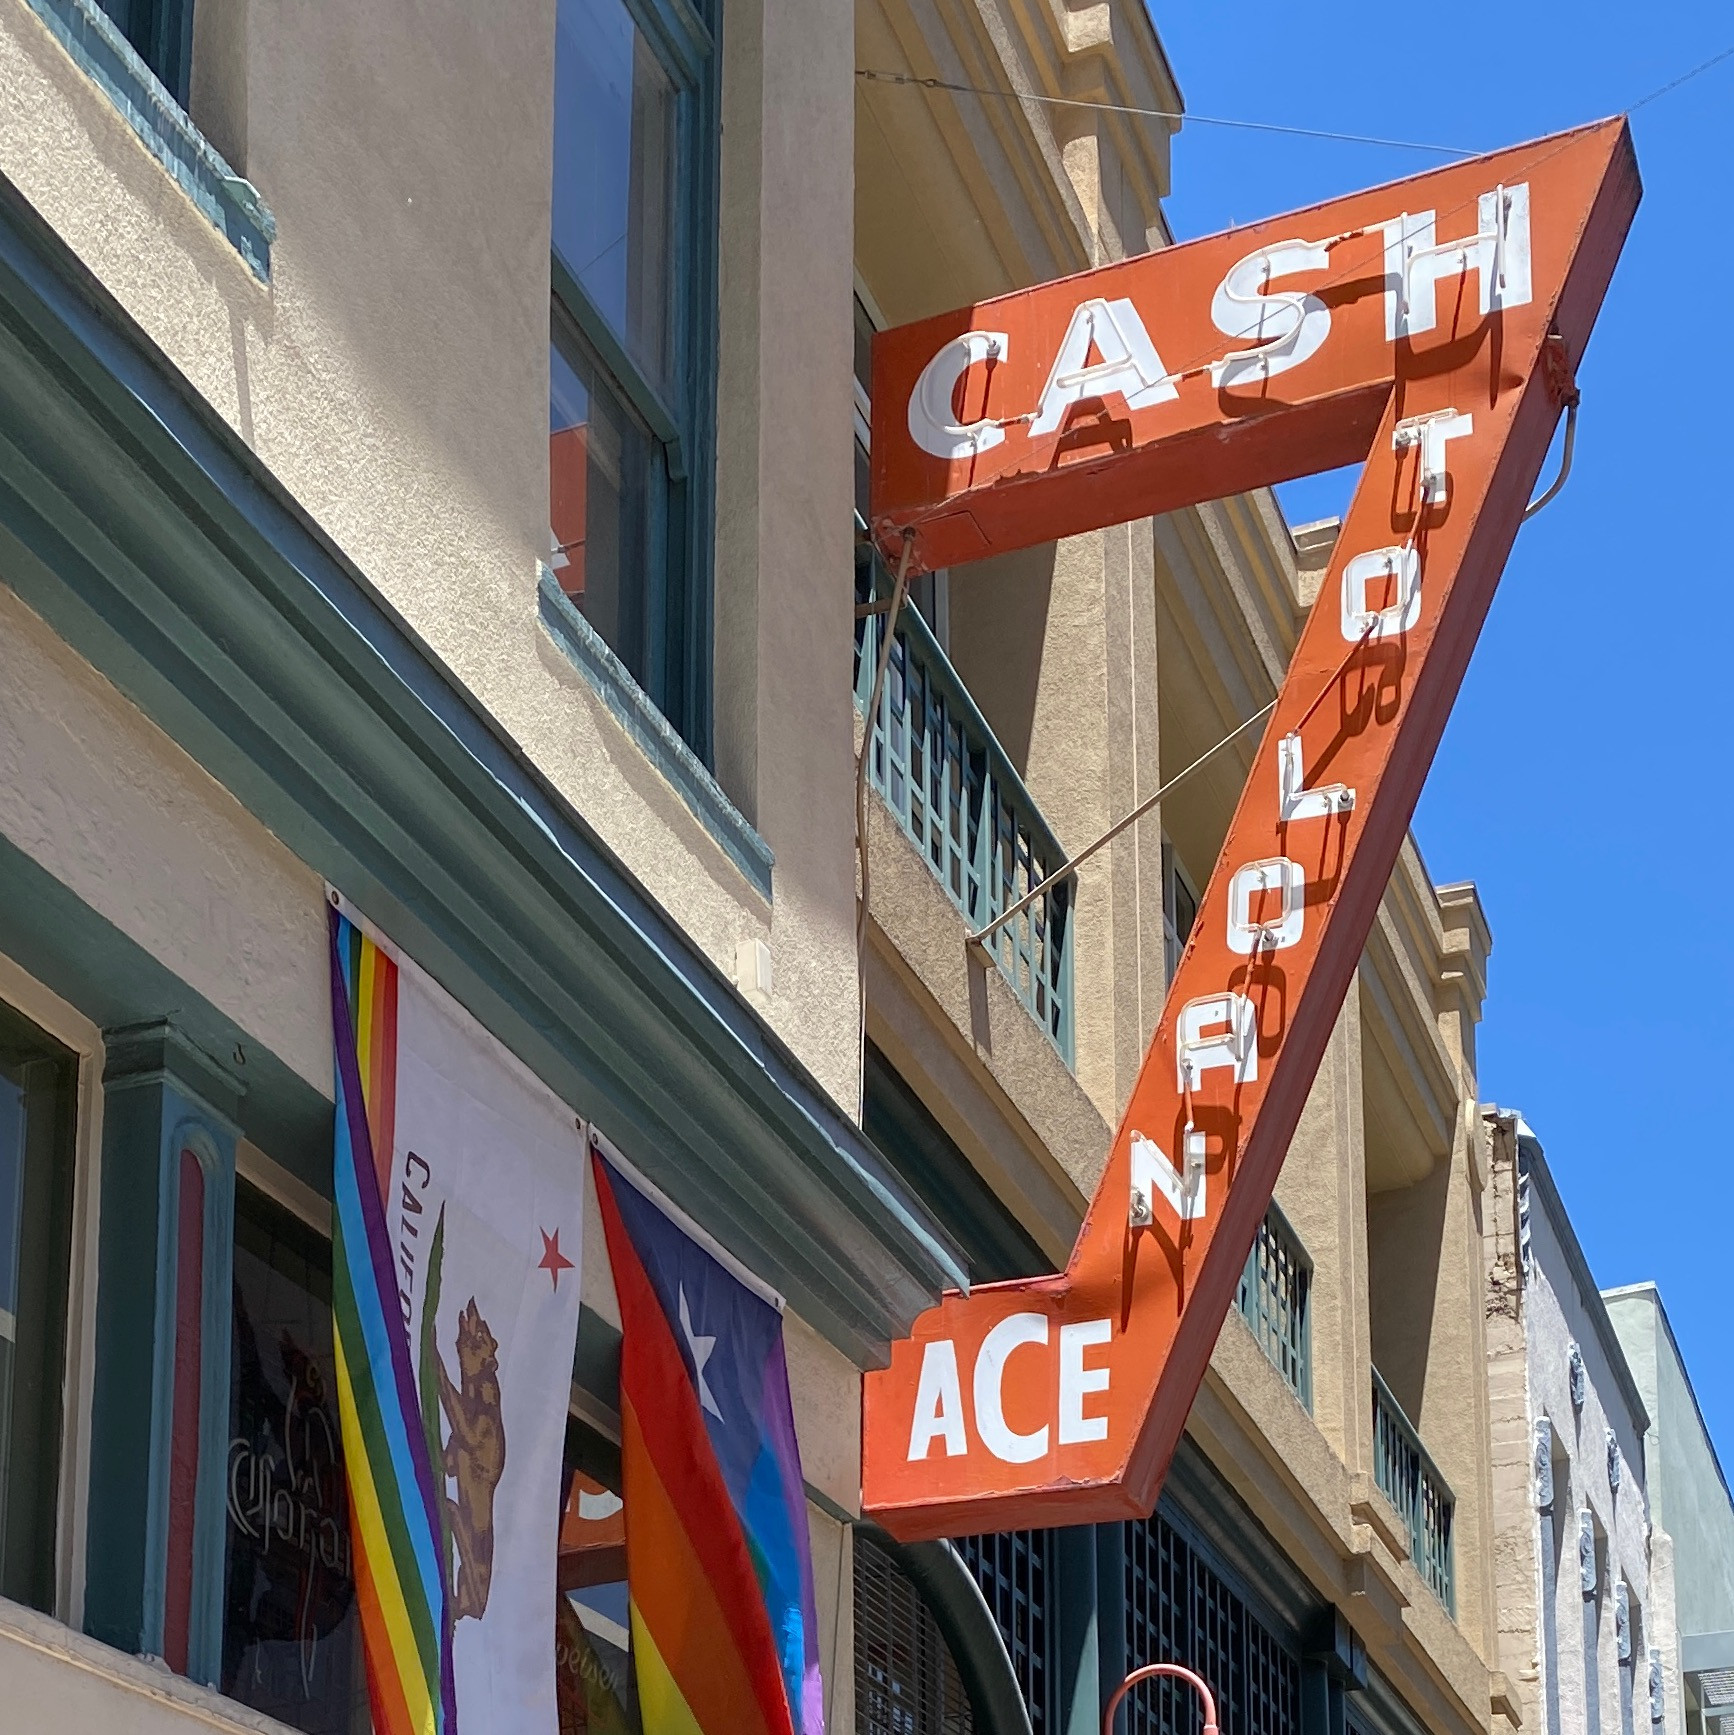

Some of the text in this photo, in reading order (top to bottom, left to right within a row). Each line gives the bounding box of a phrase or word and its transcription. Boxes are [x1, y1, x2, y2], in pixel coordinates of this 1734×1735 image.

[908, 182, 1533, 460] CASH
[1129, 408, 1474, 1227] TO LOAN
[400, 1151, 431, 1347] CALIFO
[907, 1312, 1112, 1464] ACE
